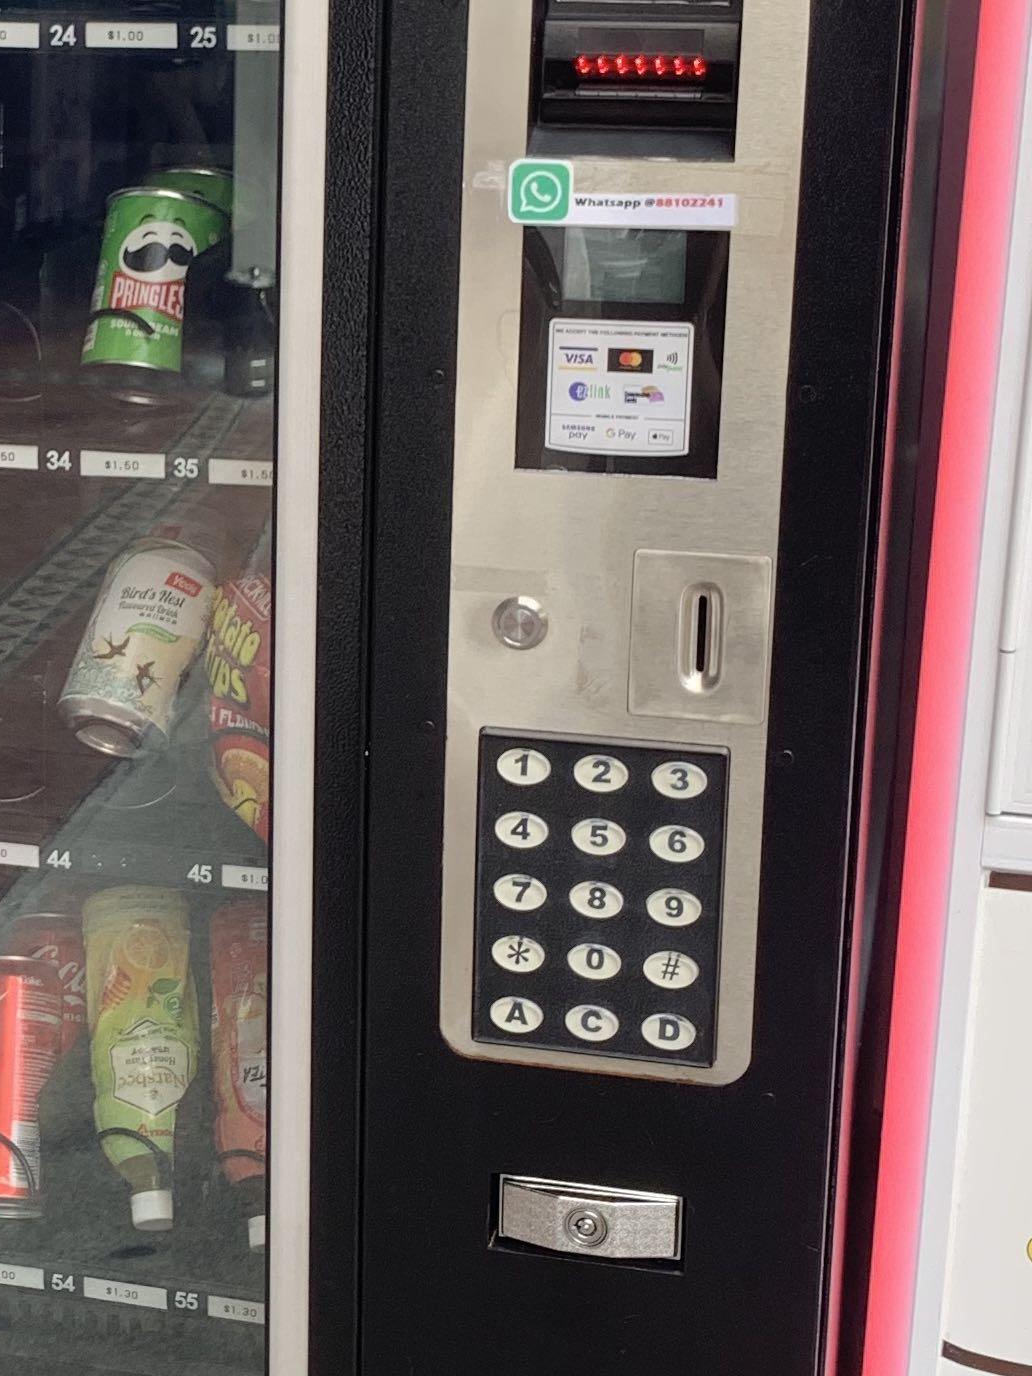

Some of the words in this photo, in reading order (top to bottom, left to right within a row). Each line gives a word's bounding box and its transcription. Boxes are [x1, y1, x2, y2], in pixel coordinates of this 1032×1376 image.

[50, 25, 76, 46] 24
[107, 30, 144, 42] $1.00
[190, 27, 217, 48] 25
[575, 197, 642, 210] Whatsapp
[110, 275, 185, 321] PRINGLES
[565, 353, 594, 364] VISA
[568, 431, 589, 441] pay
[618, 429, 637, 441] Pay
[46, 450, 71, 471] 34
[104, 460, 140, 471] $1.50
[173, 457, 199, 479] 35
[121, 586, 156, 600] Bird's
[158, 590, 186, 608] Nest
[514, 753, 528, 776] 1
[592, 761, 611, 783] 2
[670, 768, 689, 791] 3
[511, 818, 530, 840] 4
[590, 825, 609, 847] 5
[668, 831, 687, 853] 6
[46, 850, 72, 870] 44
[186, 864, 212, 884] 45
[241, 873, 268, 884] $1.0
[512, 881, 531, 903] 7
[587, 887, 606, 910] 8
[665, 896, 684, 918] 9
[662, 953, 681, 980] #
[505, 1002, 529, 1026] A
[580, 1010, 602, 1033] C
[658, 1018, 680, 1041] D
[51, 1273, 76, 1292] 54
[105, 1286, 139, 1300] $1.30
[174, 1291, 199, 1310] 55
[223, 1305, 257, 1318] $1.30
